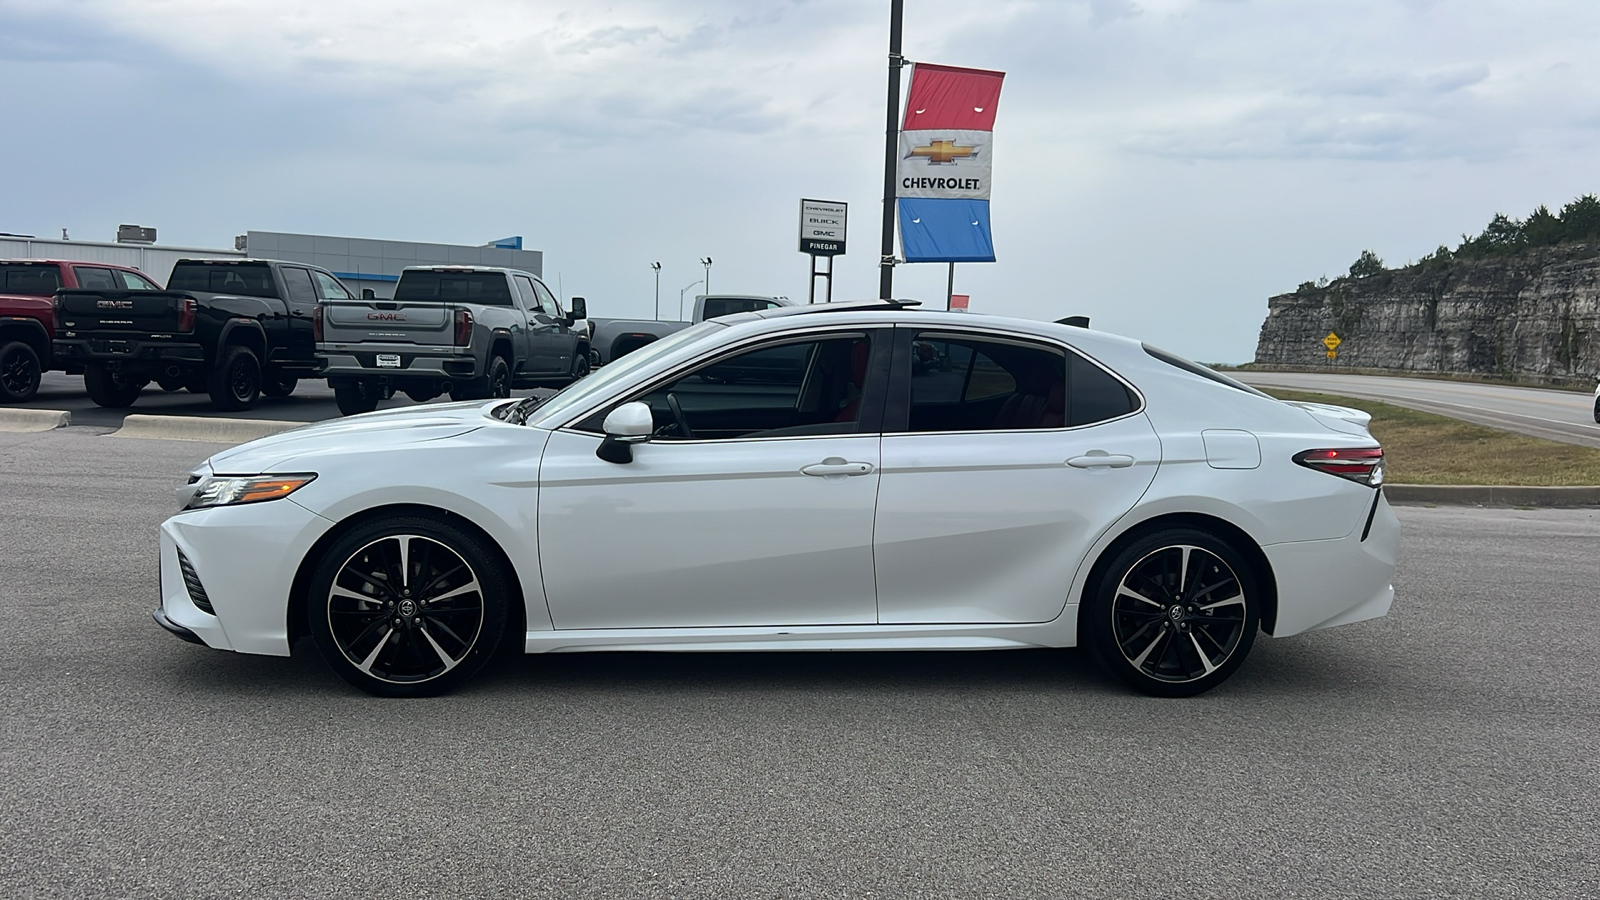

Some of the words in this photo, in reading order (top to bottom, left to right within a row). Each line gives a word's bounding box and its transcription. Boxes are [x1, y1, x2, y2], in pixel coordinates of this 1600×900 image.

[902, 177, 980, 190] CHEVROLET
[809, 217, 839, 225] BUICK
[809, 242, 838, 251] PINEGAR
[97, 300, 133, 309] GMC
[367, 313, 407, 321] GMC
